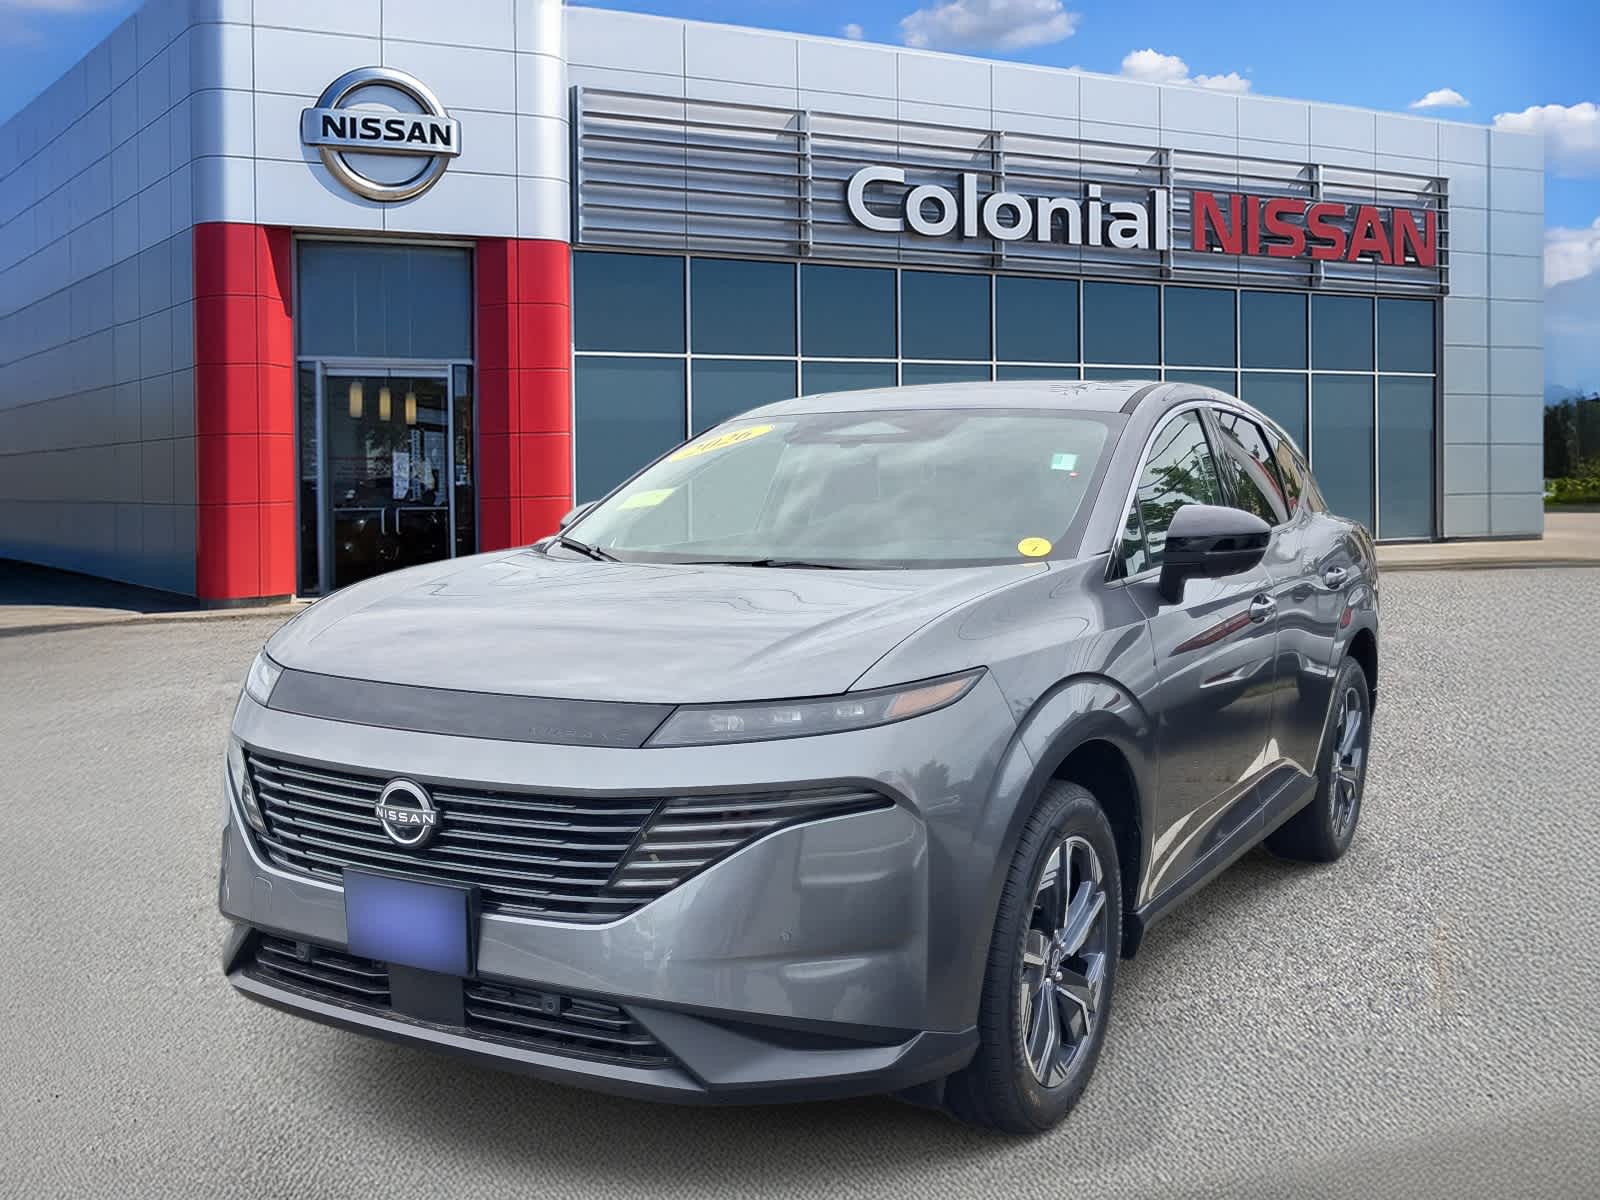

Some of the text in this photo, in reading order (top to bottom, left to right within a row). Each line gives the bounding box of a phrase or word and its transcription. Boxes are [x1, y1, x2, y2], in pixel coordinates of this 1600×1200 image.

[321, 115, 452, 147] NISSAN
[846, 165, 1436, 267] Colonial NISSAN
[375, 805, 434, 824] NISSAN
